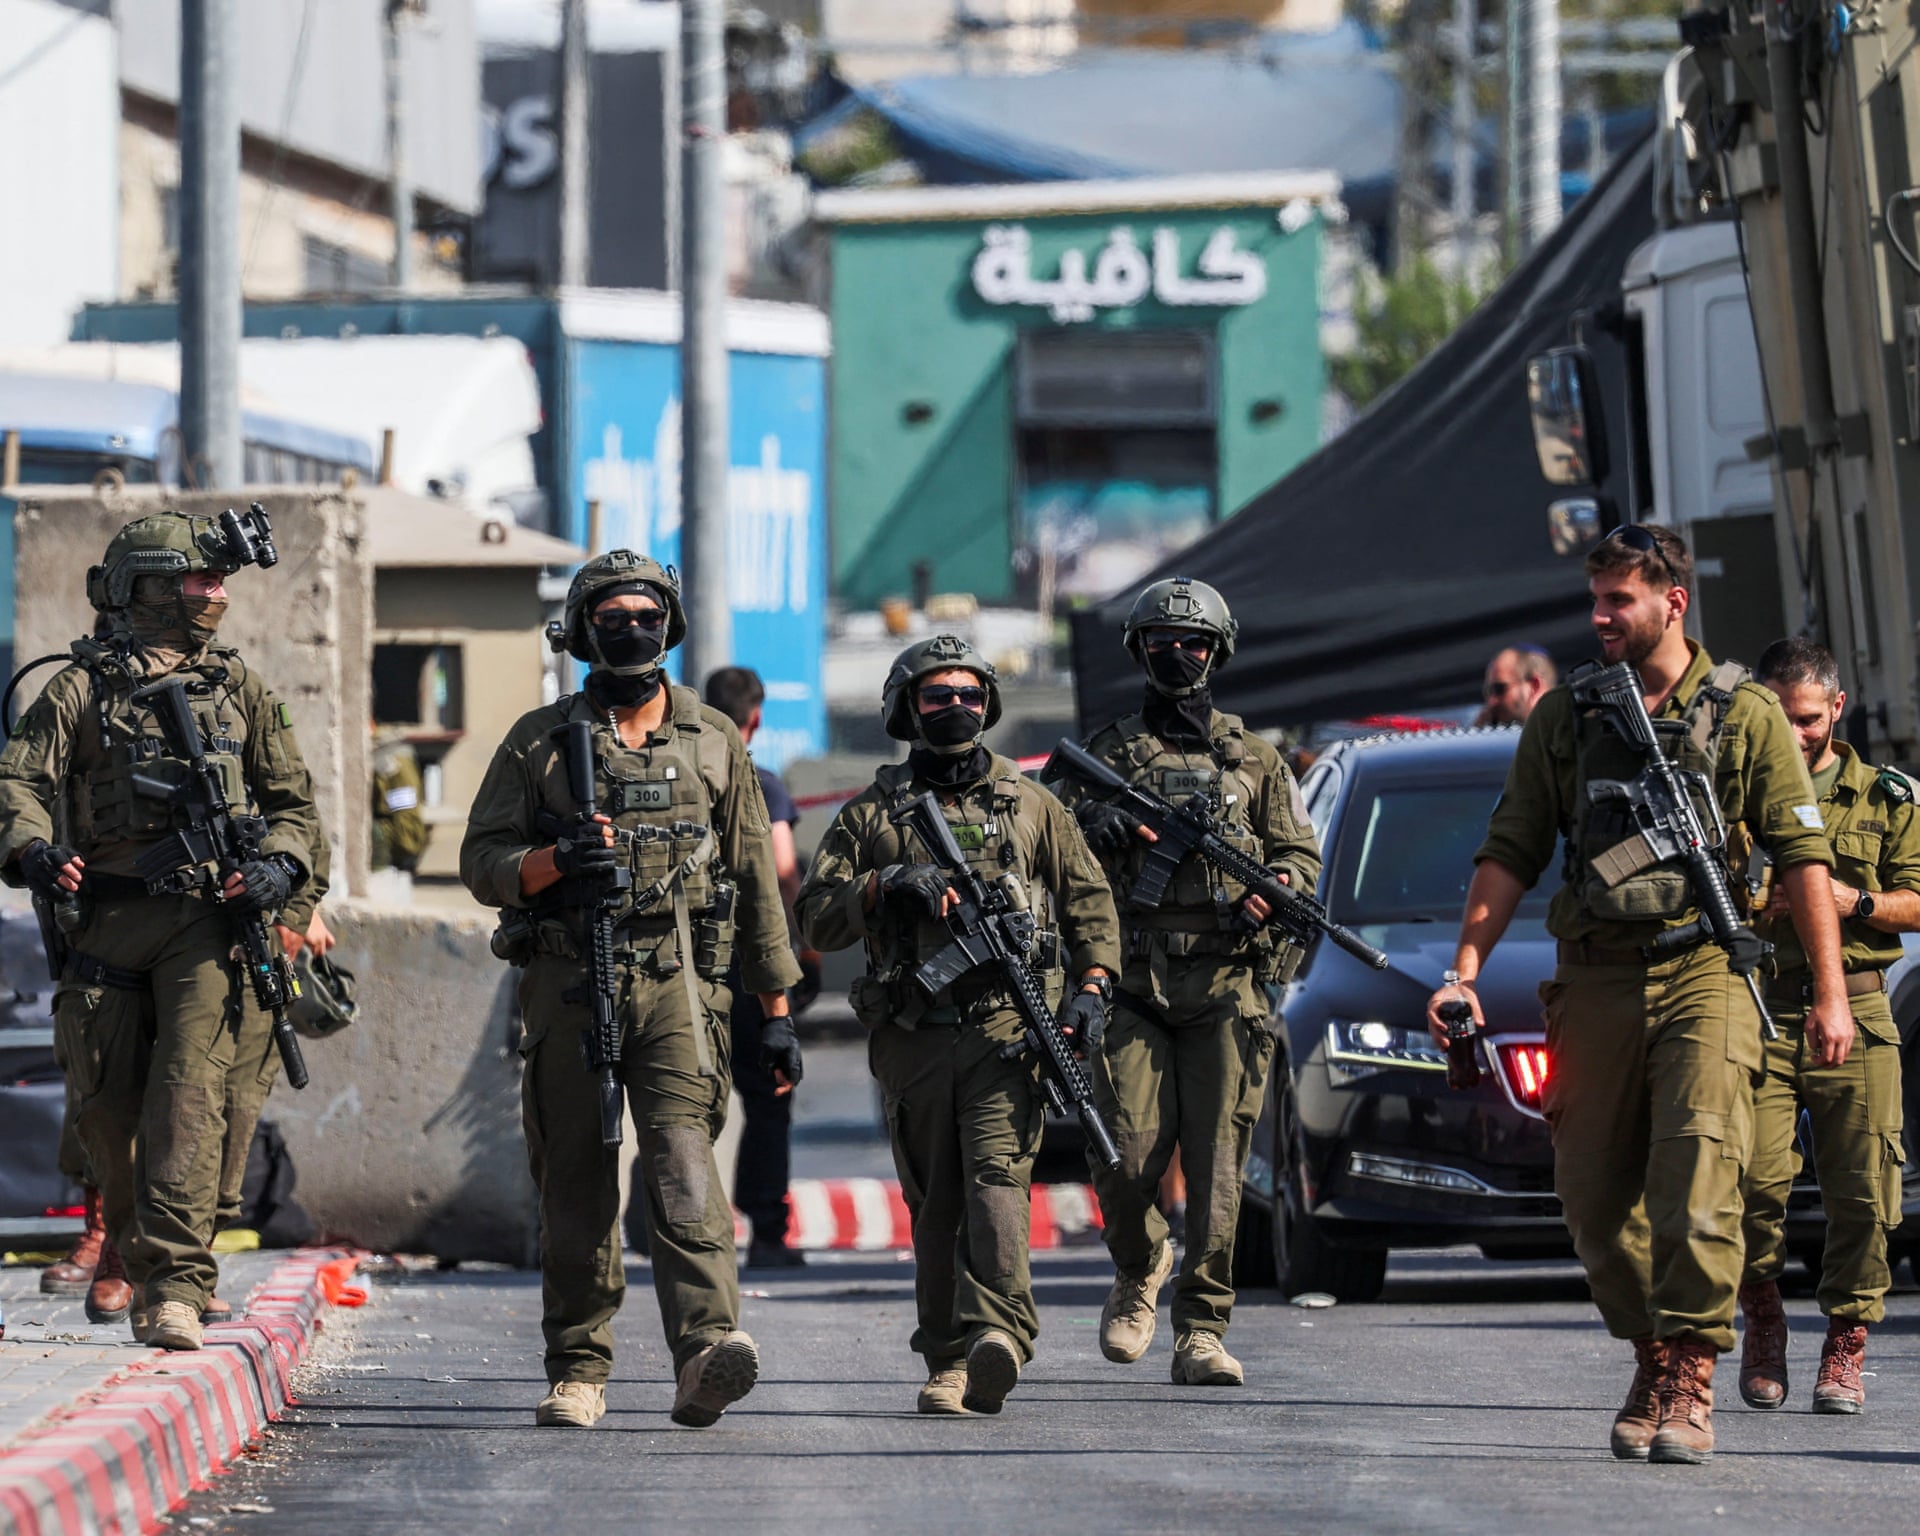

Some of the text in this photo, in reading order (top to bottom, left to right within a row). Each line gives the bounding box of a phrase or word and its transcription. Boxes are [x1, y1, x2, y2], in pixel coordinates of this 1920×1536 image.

[971, 224, 1266, 324] كافية
[1174, 775, 1199, 788] 300
[634, 790, 660, 802] 300
